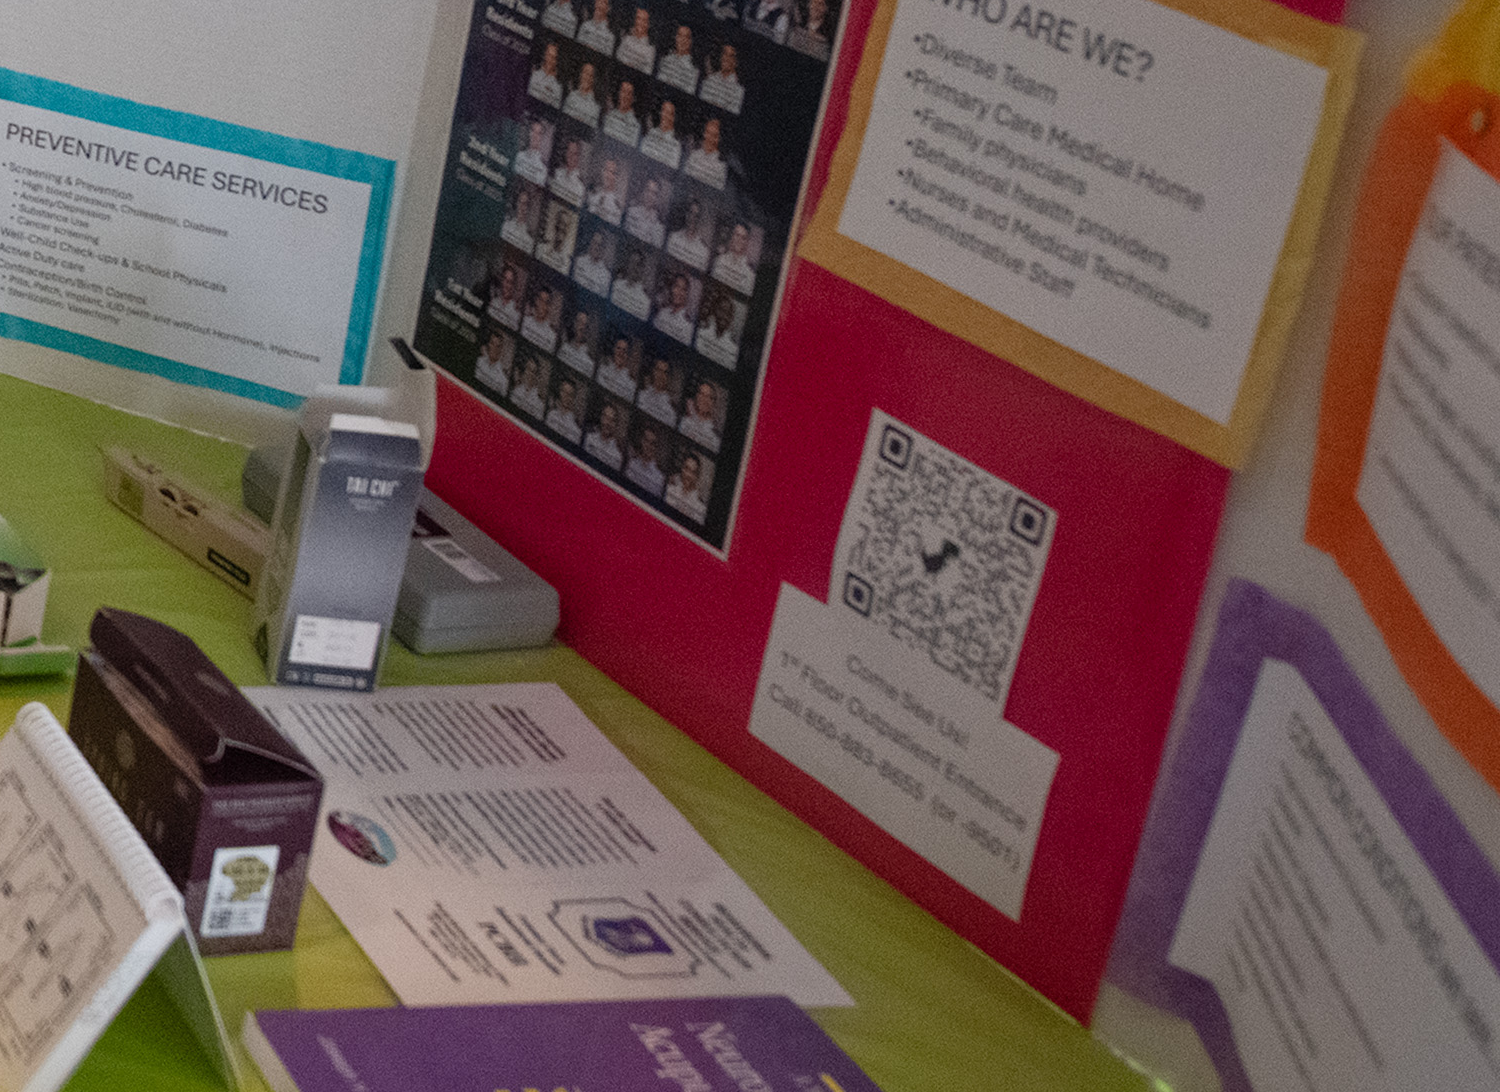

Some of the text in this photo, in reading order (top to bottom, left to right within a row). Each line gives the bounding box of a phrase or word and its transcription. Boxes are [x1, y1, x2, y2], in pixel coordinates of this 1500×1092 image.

[920, 32, 1059, 106] Diverse Team
[1010, 4, 1077, 54] ARE
[1083, 26, 1155, 83] WE?
[6, 123, 329, 214] PREVENTIVE CARE SERVICES
[910, 67, 1205, 213] Primary Care Medical Home
[918, 109, 1088, 196] Family physicians
[8, 162, 134, 201] Screening & Prevention
[17, 204, 68, 222] Substance
[21, 179, 44, 192] High
[911, 138, 1170, 273] Behavioral health providers
[0, 227, 57, 248] Well-Child
[121, 258, 129, 268] &
[131, 260, 172, 279] School
[173, 270, 228, 293] Physicals
[16, 216, 100, 245] Cancer screening
[33, 249, 59, 267] Duty
[60, 260, 86, 272] care
[895, 199, 1076, 299] Administrative Staff
[904, 167, 1213, 330] Nurses and Medical Technicians
[105, 286, 148, 305] Control
